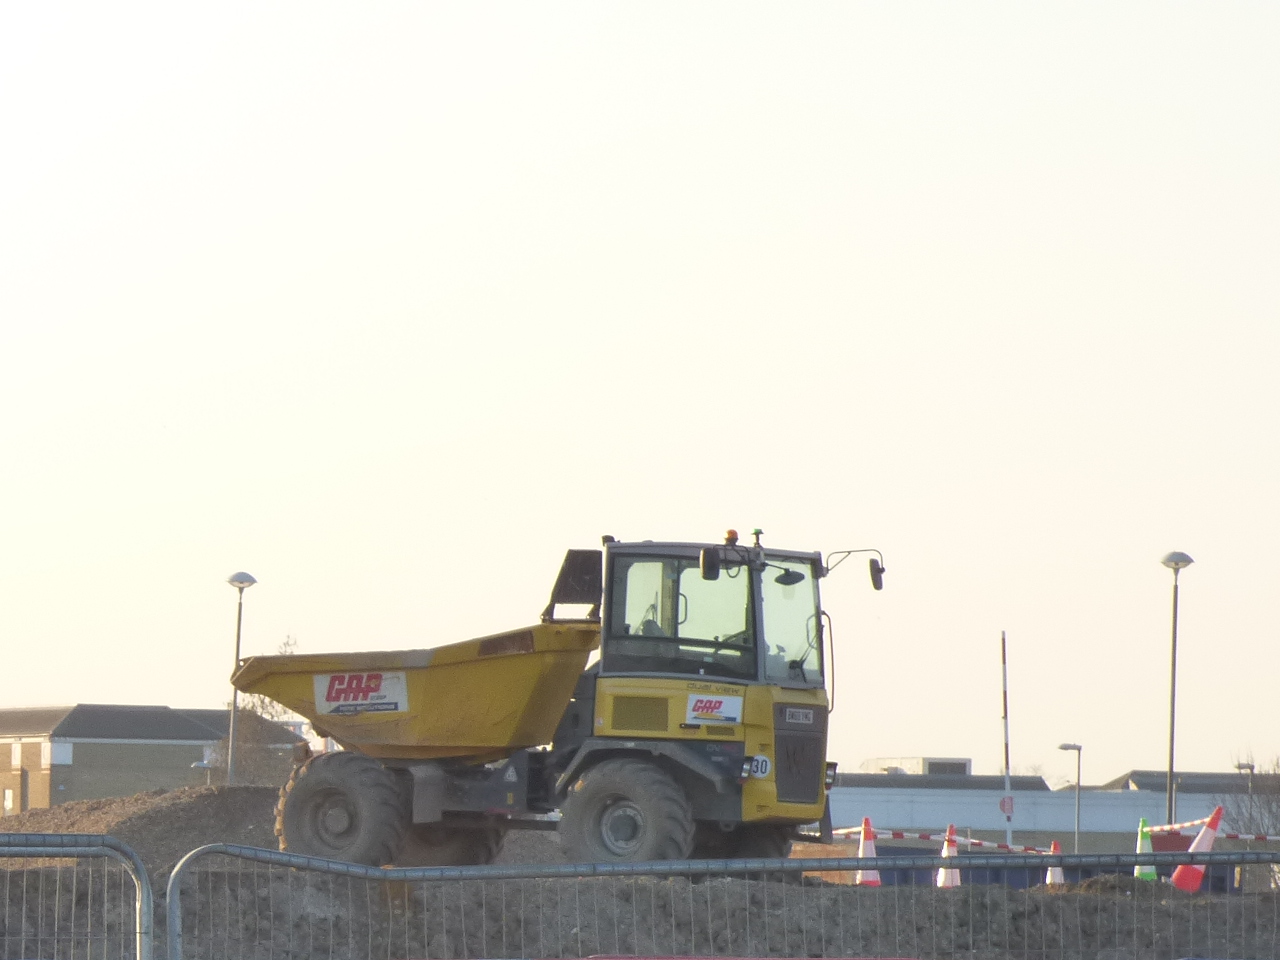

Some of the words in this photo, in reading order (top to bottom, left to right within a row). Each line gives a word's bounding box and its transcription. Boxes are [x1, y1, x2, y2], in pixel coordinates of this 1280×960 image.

[325, 673, 383, 702] GAP
[692, 699, 723, 713] GAP
[752, 759, 768, 774] 30
